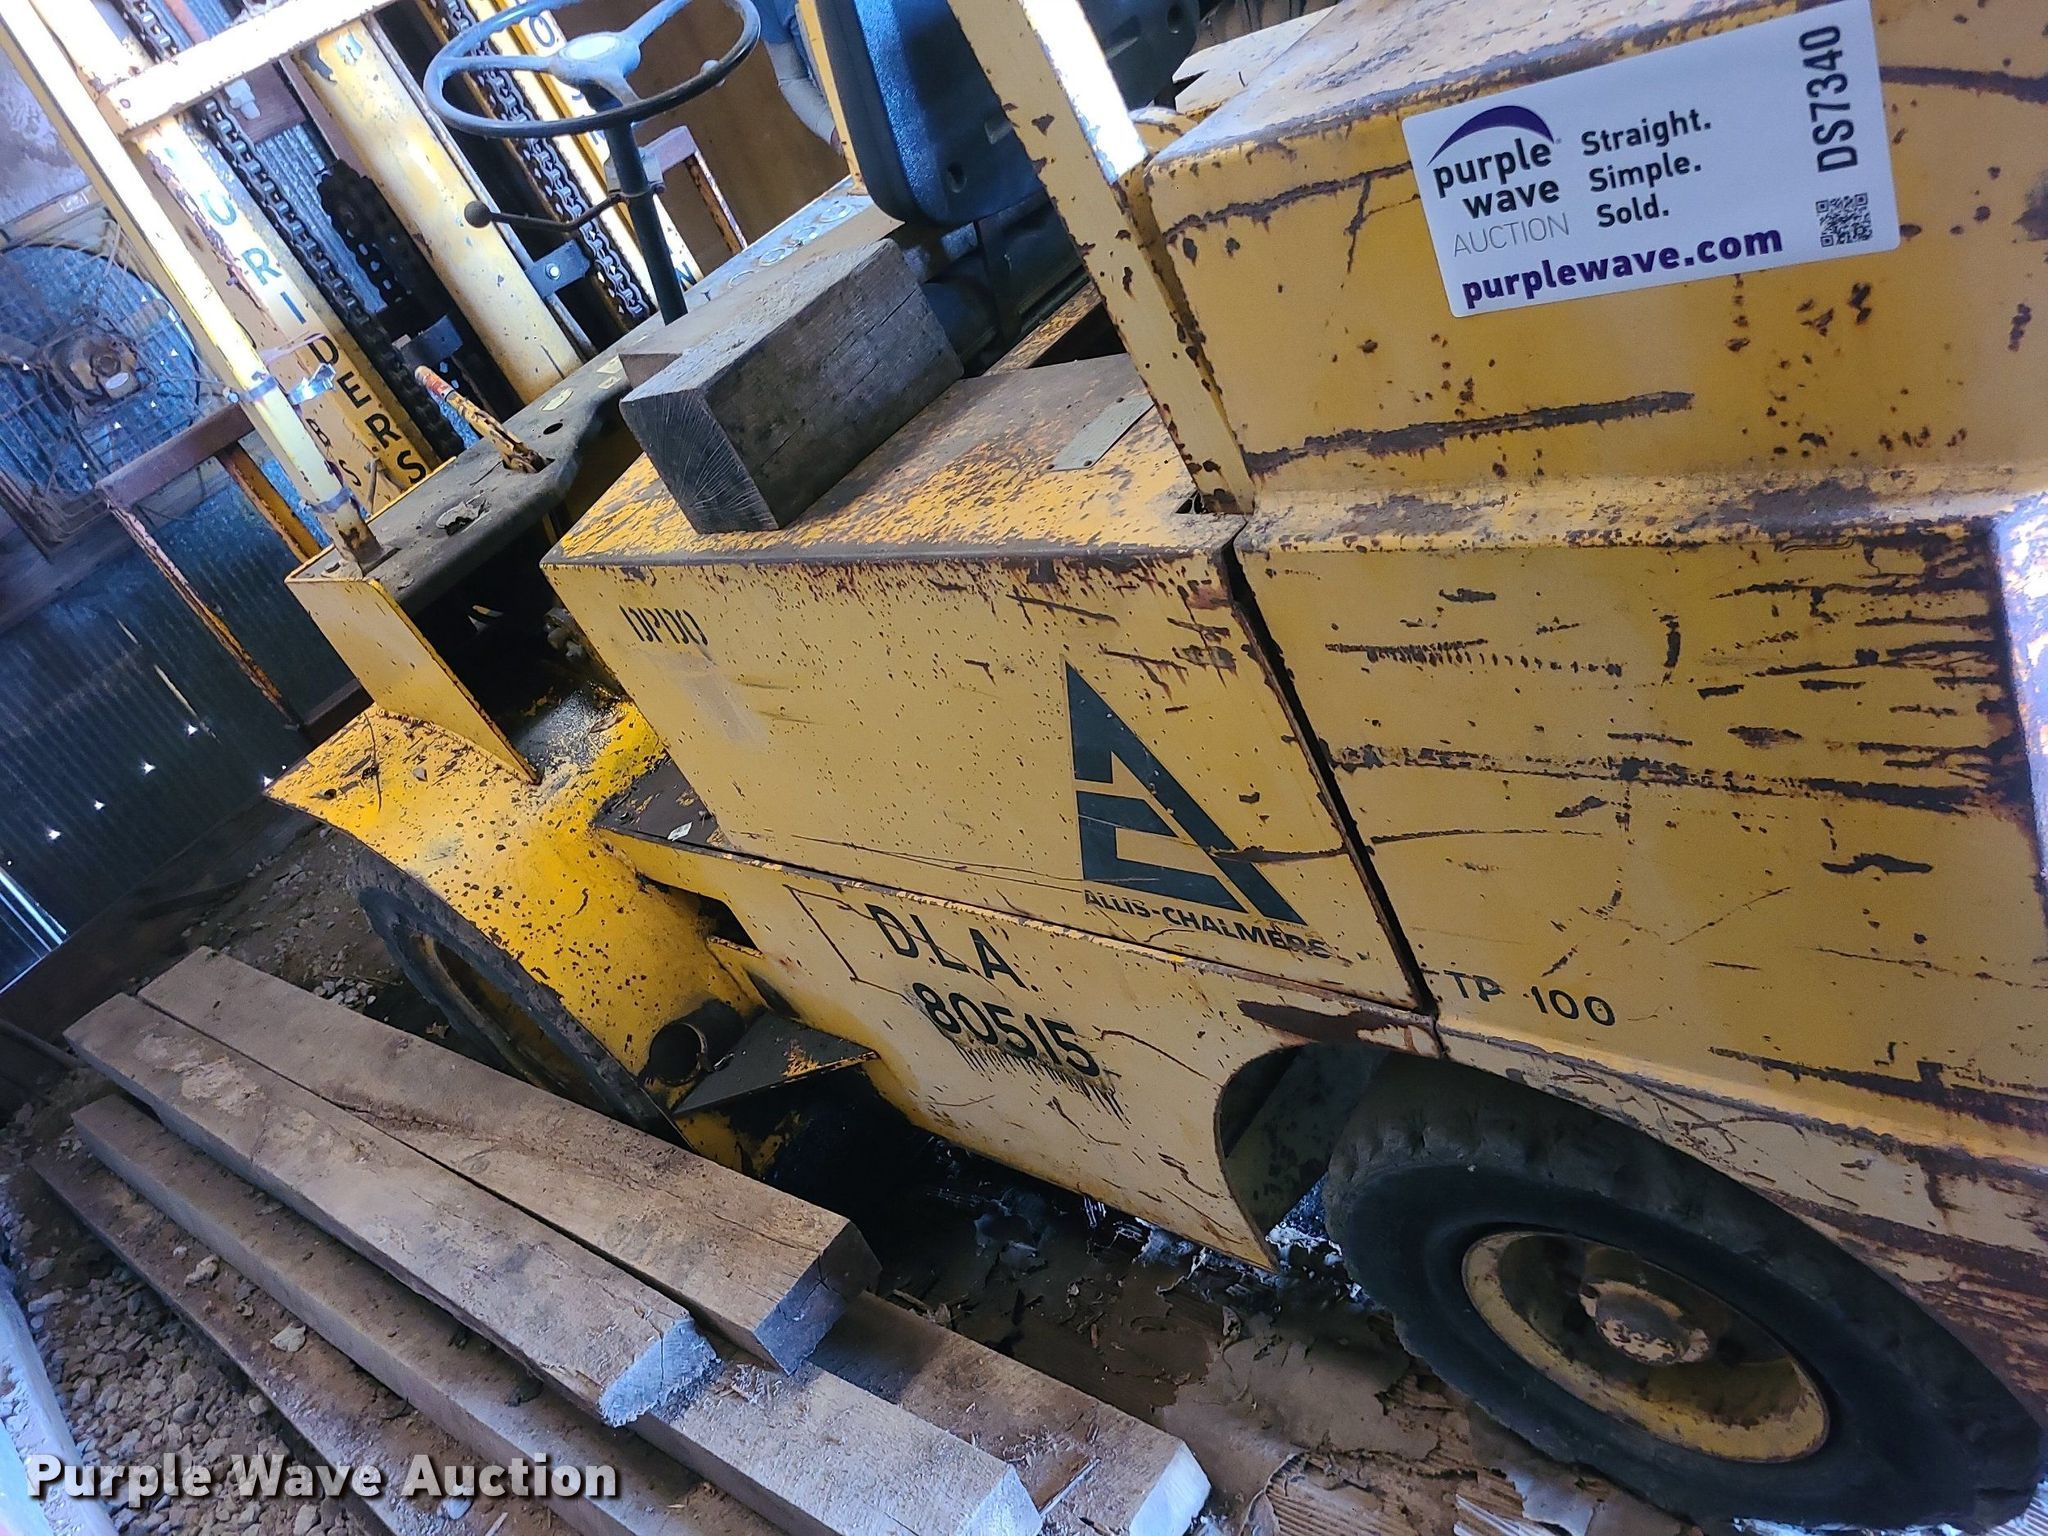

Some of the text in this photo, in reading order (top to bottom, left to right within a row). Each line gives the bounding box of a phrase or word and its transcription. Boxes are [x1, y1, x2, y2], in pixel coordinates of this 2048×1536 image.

[1799, 25, 1858, 173] DS7340
[1581, 109, 1712, 157] Straight.
[1432, 138, 1552, 198] purple
[1589, 152, 1702, 195] Simple.
[1463, 180, 1560, 219] wave
[1597, 196, 1670, 228] Sold.
[1453, 212, 1570, 258] AUCTION
[1462, 228, 1783, 309] purplewave.com
[1084, 889, 1330, 959] ALLIS-CHALMERS
[912, 982, 1100, 1077] 80515
[1530, 985, 1615, 1026] 100
